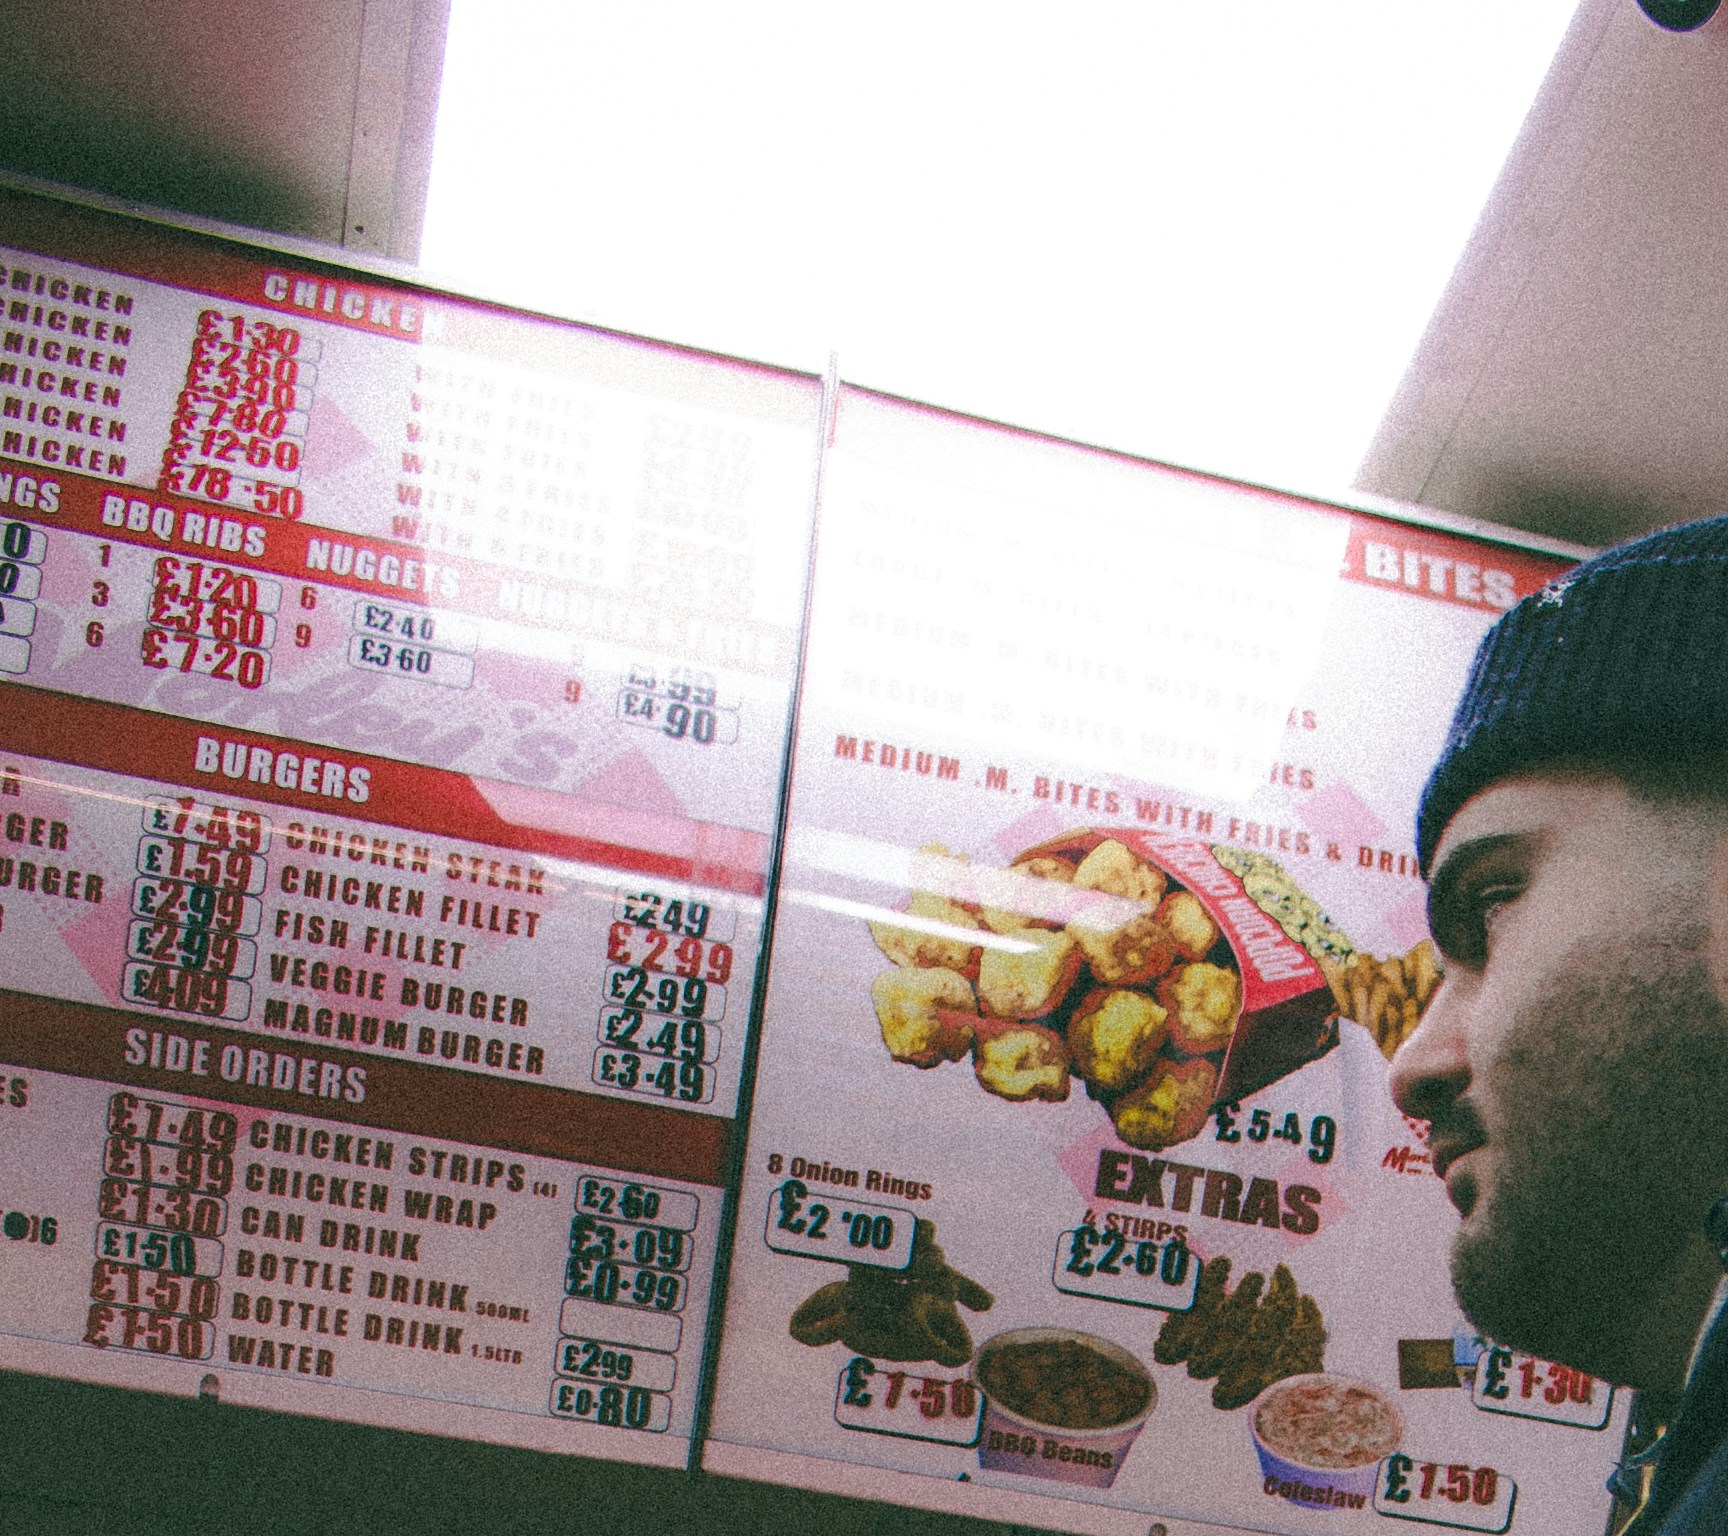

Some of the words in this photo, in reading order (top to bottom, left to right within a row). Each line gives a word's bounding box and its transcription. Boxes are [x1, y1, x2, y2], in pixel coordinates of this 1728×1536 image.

[0, 300, 132, 346] HICKEN
[197, 309, 300, 356] £1.30
[263, 272, 446, 338] CHICKEN
[103, 493, 175, 543] BBQ
[183, 511, 267, 558] RIBS
[99, 544, 112, 568] 1
[154, 556, 259, 612] £1.20
[306, 538, 460, 598] NUGGETS
[1363, 542, 1519, 609] BITES
[91, 580, 110, 607] 3
[300, 586, 318, 611] 6
[85, 620, 104, 648] 6
[294, 623, 312, 648] 9
[364, 604, 435, 641] £2.40
[142, 626, 266, 690] £7.20
[360, 639, 432, 674] £3.60
[565, 679, 582, 704] 9
[624, 693, 717, 744] £4.90
[195, 736, 371, 803] BURGERS
[834, 734, 961, 781] MEDIUM
[1033, 776, 1121, 815] BITES
[1136, 797, 1214, 837] WITH
[1228, 816, 1311, 856] FRIES
[1325, 841, 1343, 863] &
[0, 812, 69, 850] GER
[286, 821, 431, 875] CHICKEN
[446, 852, 547, 896] STEAK
[145, 836, 254, 894] £1.59
[139, 876, 245, 934] £2.99
[280, 864, 427, 918] CHICKEN
[440, 895, 541, 938] FILLET
[275, 908, 351, 950] FISH
[364, 925, 467, 970] FILLET
[270, 953, 389, 1002] VEGGIE
[402, 976, 529, 1028] BURGER
[125, 1027, 211, 1075] SIDE
[220, 1043, 368, 1103] ORDERS
[263, 998, 408, 1052] MAGNUM
[416, 1026, 546, 1077] BURGER
[606, 1008, 707, 1065] £2.49
[600, 1053, 705, 1103] £3.49
[109, 1092, 237, 1154] £1.49
[250, 1119, 394, 1171] CHICKEN
[408, 1145, 525, 1194] STRIPS
[767, 1153, 783, 1176] 8
[790, 1157, 859, 1188] Onion
[866, 1168, 933, 1201] Rings
[245, 1163, 389, 1214] CHICKEN
[404, 1188, 497, 1231] WRAP
[1095, 1149, 1323, 1237] EXTRAS
[103, 1228, 196, 1277] £1.50
[241, 1206, 304, 1243] CAN
[320, 1219, 421, 1262] DRINK
[570, 1215, 683, 1269] £3.09
[1065, 1224, 1189, 1286] £2.60
[1103, 1210, 1189, 1244] STIRPS
[90, 1258, 218, 1319] £1.50
[236, 1248, 354, 1295] BOTTLE
[369, 1270, 469, 1313] DRINK
[475, 1299, 530, 1323] 500ML
[566, 1256, 681, 1311] £0.99
[82, 1301, 205, 1360] £1.50
[231, 1292, 349, 1338] BOTTLE
[364, 1312, 465, 1355] DRINK
[228, 1334, 336, 1379] WATER
[557, 1385, 653, 1429] £0.80
[843, 1356, 977, 1420] £1.50
[988, 1429, 1036, 1457] BBQ
[1042, 1438, 1114, 1470] Beans
[1263, 1474, 1367, 1511] Coleslaw
[1384, 1452, 1498, 1506] £1.50
